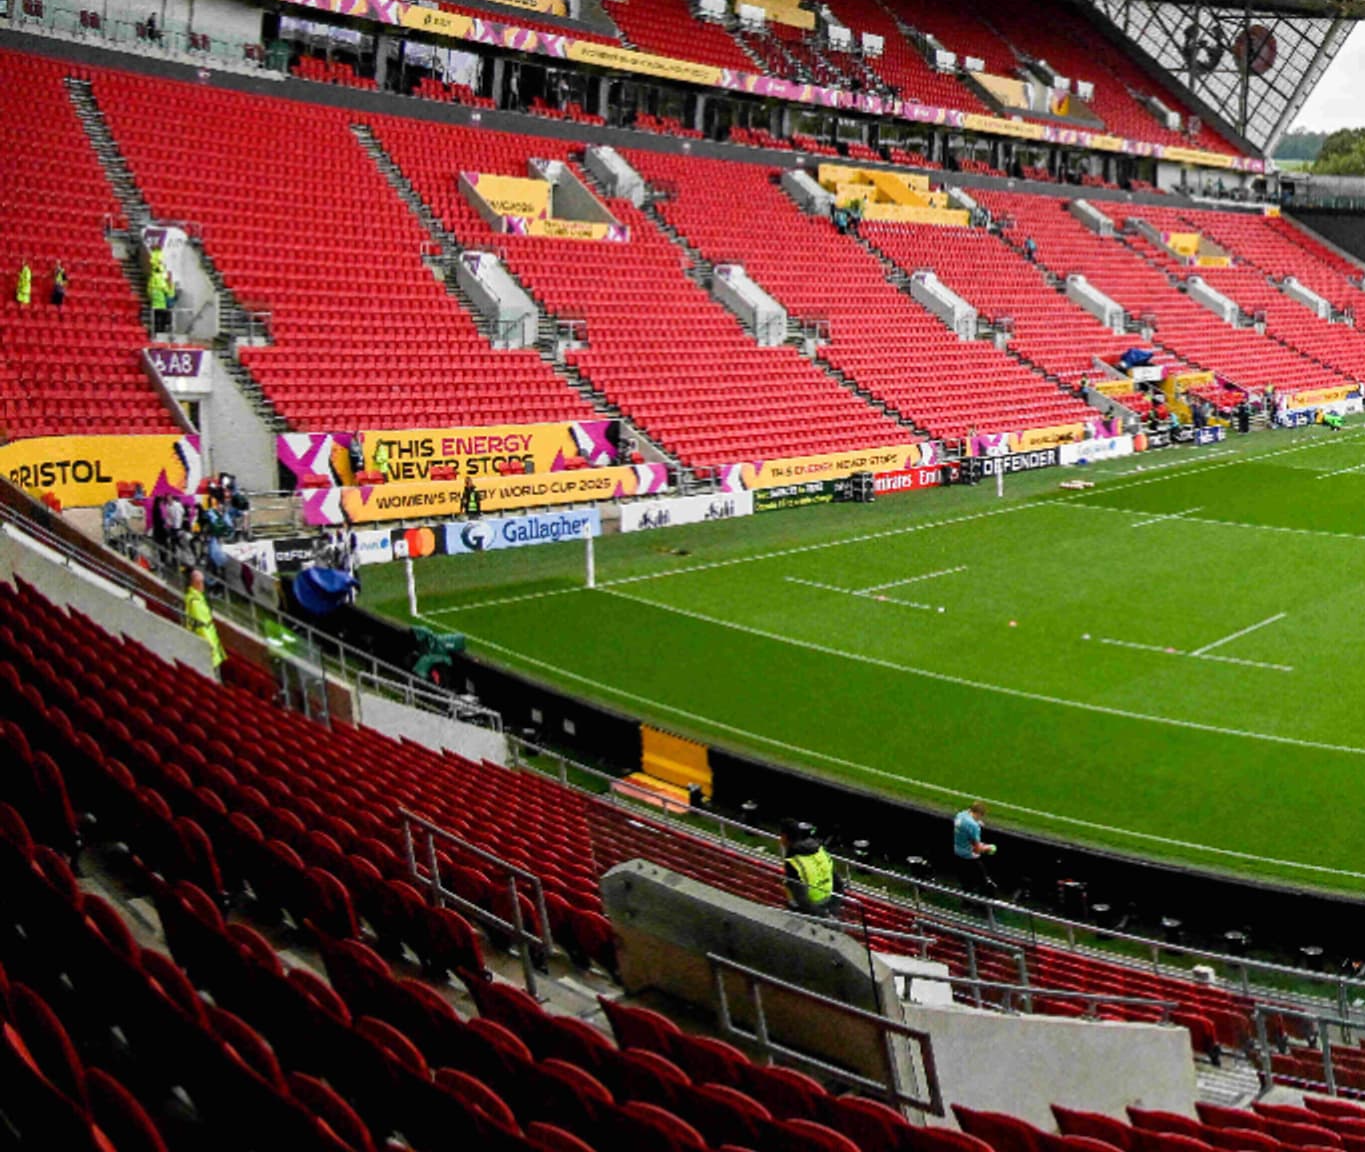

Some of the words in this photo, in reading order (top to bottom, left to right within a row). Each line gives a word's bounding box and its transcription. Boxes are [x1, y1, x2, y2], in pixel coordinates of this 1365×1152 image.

[169, 353, 193, 374] A8
[386, 439, 435, 460] THIS
[441, 433, 533, 456] ENERGY
[9, 459, 113, 489] BRISTOL
[982, 450, 1057, 477] DEFENDER
[376, 489, 447, 510] WOMEN'S
[499, 483, 548, 498] WORLD
[550, 480, 577, 495] CUP
[579, 477, 612, 492] 2025
[874, 472, 913, 491] mirates
[502, 512, 589, 544] Gallagher
